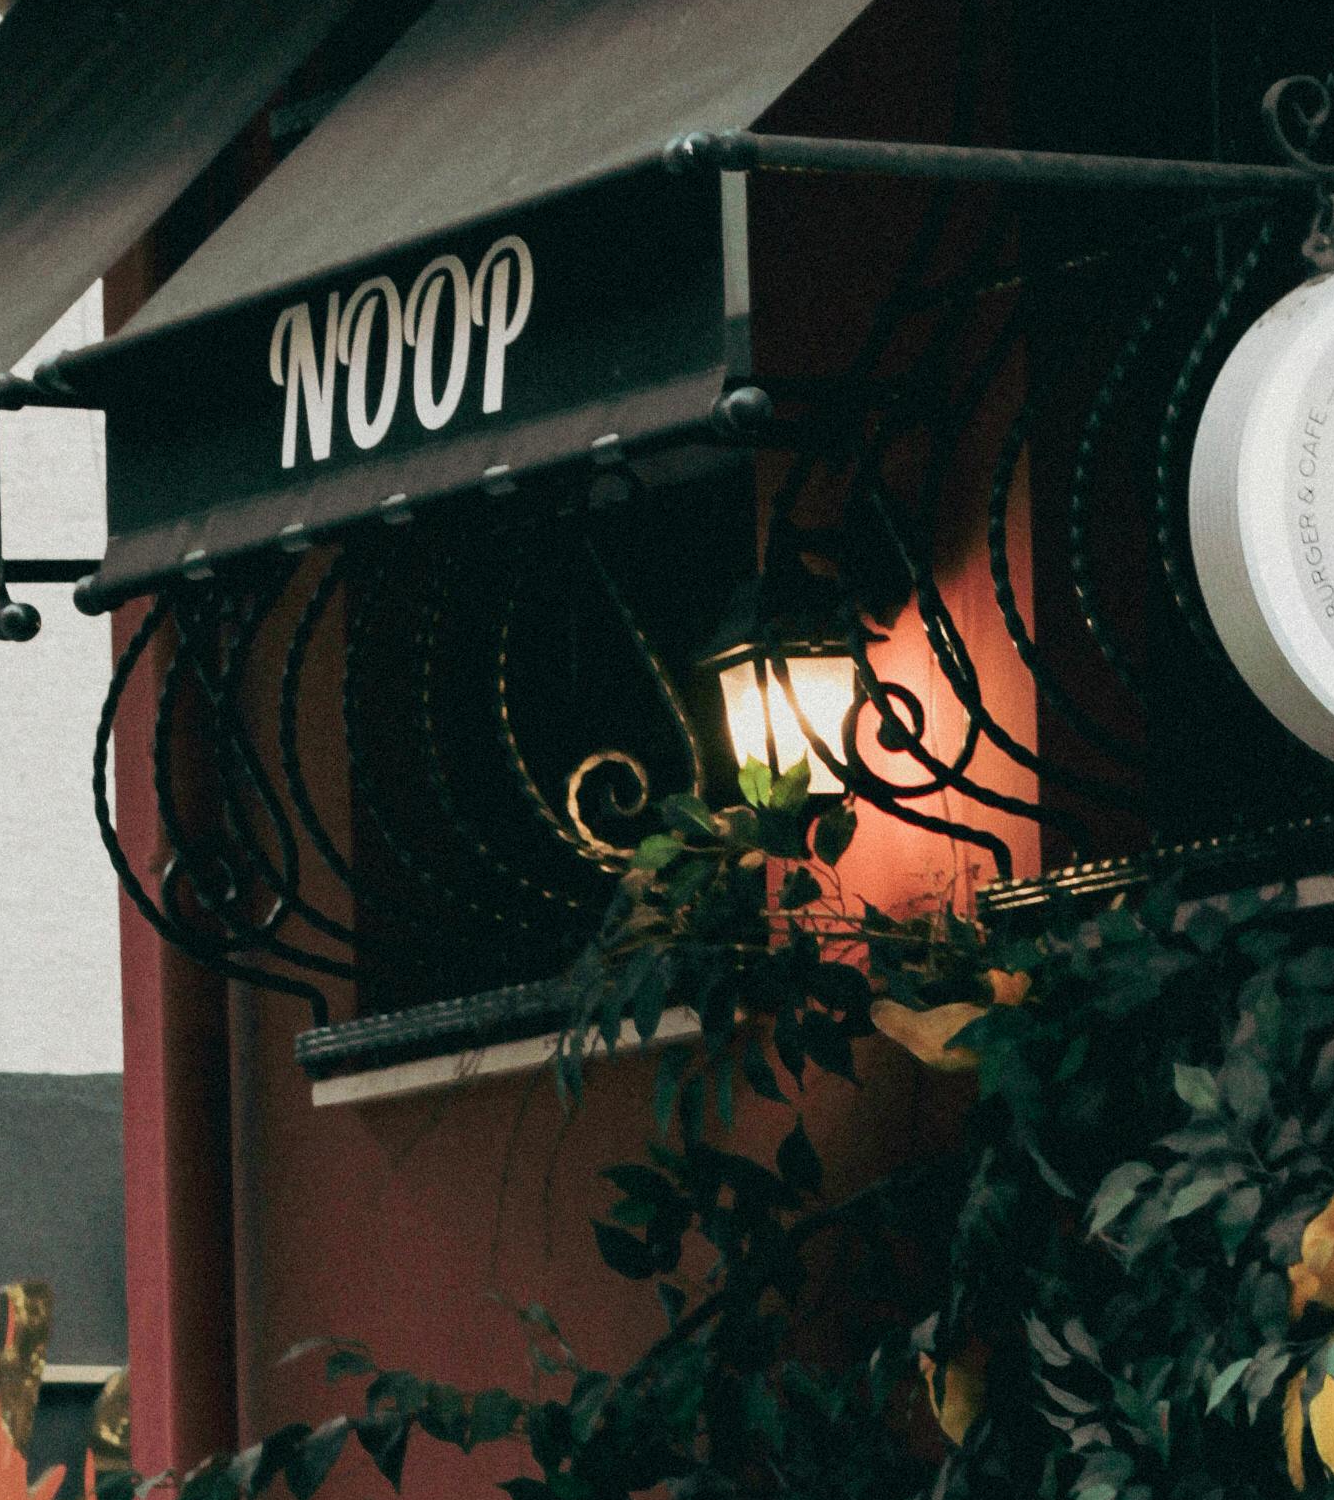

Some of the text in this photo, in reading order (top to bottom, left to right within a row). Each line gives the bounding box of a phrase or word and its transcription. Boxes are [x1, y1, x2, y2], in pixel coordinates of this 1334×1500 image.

[269, 234, 534, 469] NOOP
[1298, 406, 1328, 478] CAFE
[1297, 485, 1315, 505] &
